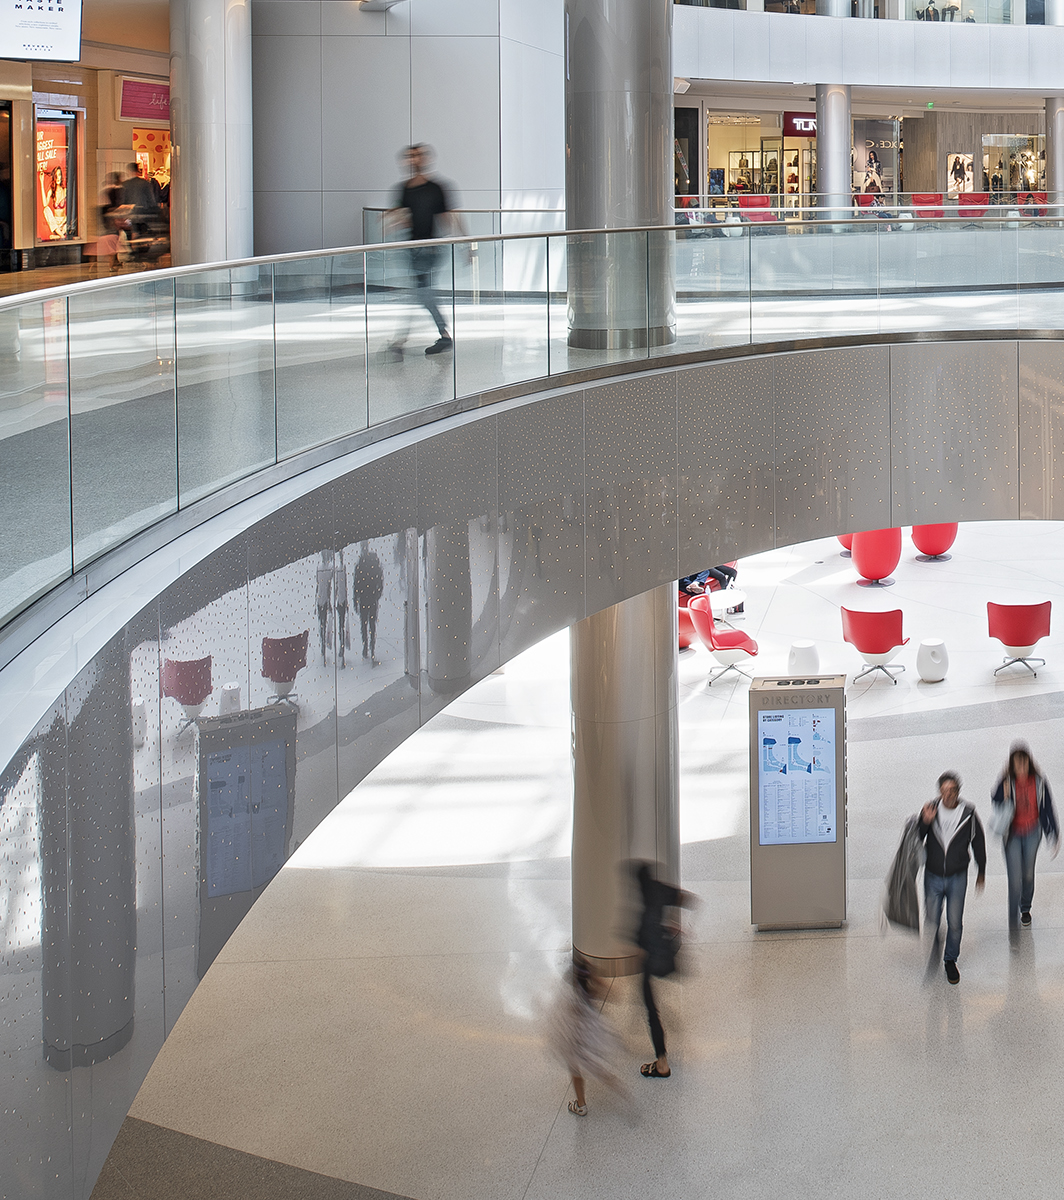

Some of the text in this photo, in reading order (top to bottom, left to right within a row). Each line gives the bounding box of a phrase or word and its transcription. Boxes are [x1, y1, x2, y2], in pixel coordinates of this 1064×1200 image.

[14, 4, 64, 13] MAKER
[45, 149, 57, 160] SALE
[762, 695, 830, 704] DIRECTORY
